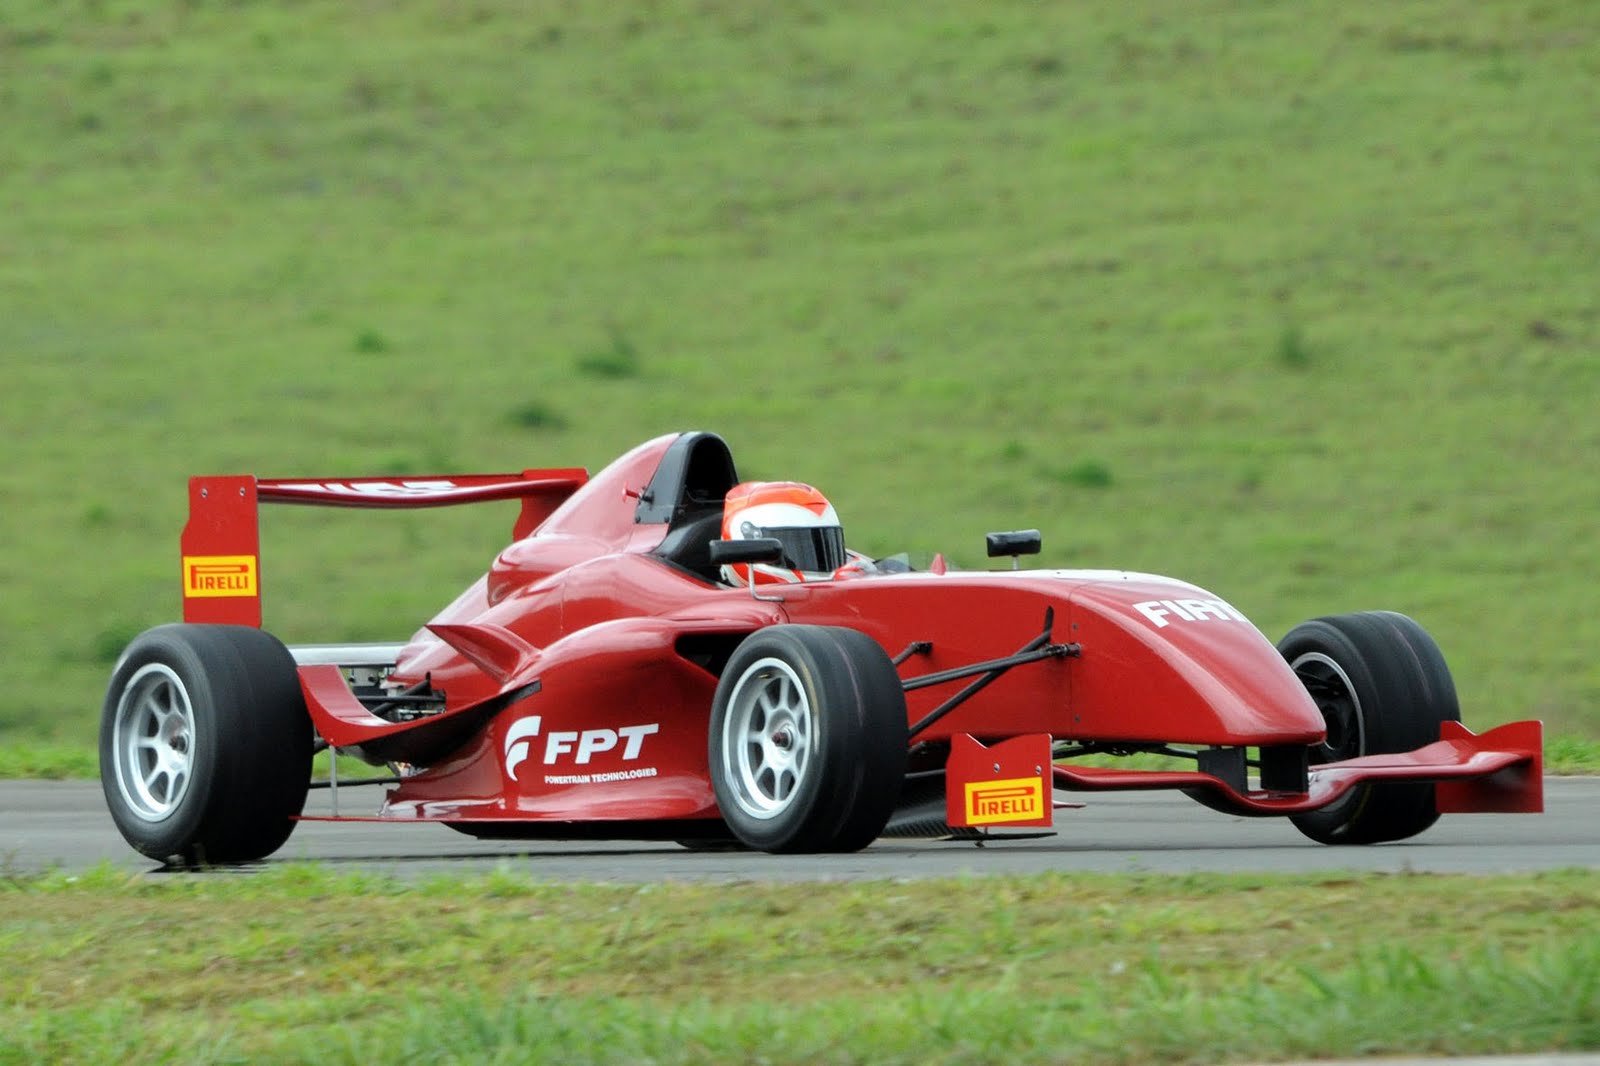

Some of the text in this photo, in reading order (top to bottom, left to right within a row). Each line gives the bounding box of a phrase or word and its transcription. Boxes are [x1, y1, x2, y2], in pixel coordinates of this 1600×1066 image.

[190, 564, 249, 589] PIRELLI
[543, 723, 659, 765] FPT
[544, 767, 658, 785] POWERTRAIN TECHNOLOGIES
[972, 786, 1036, 816] PIRELLI
